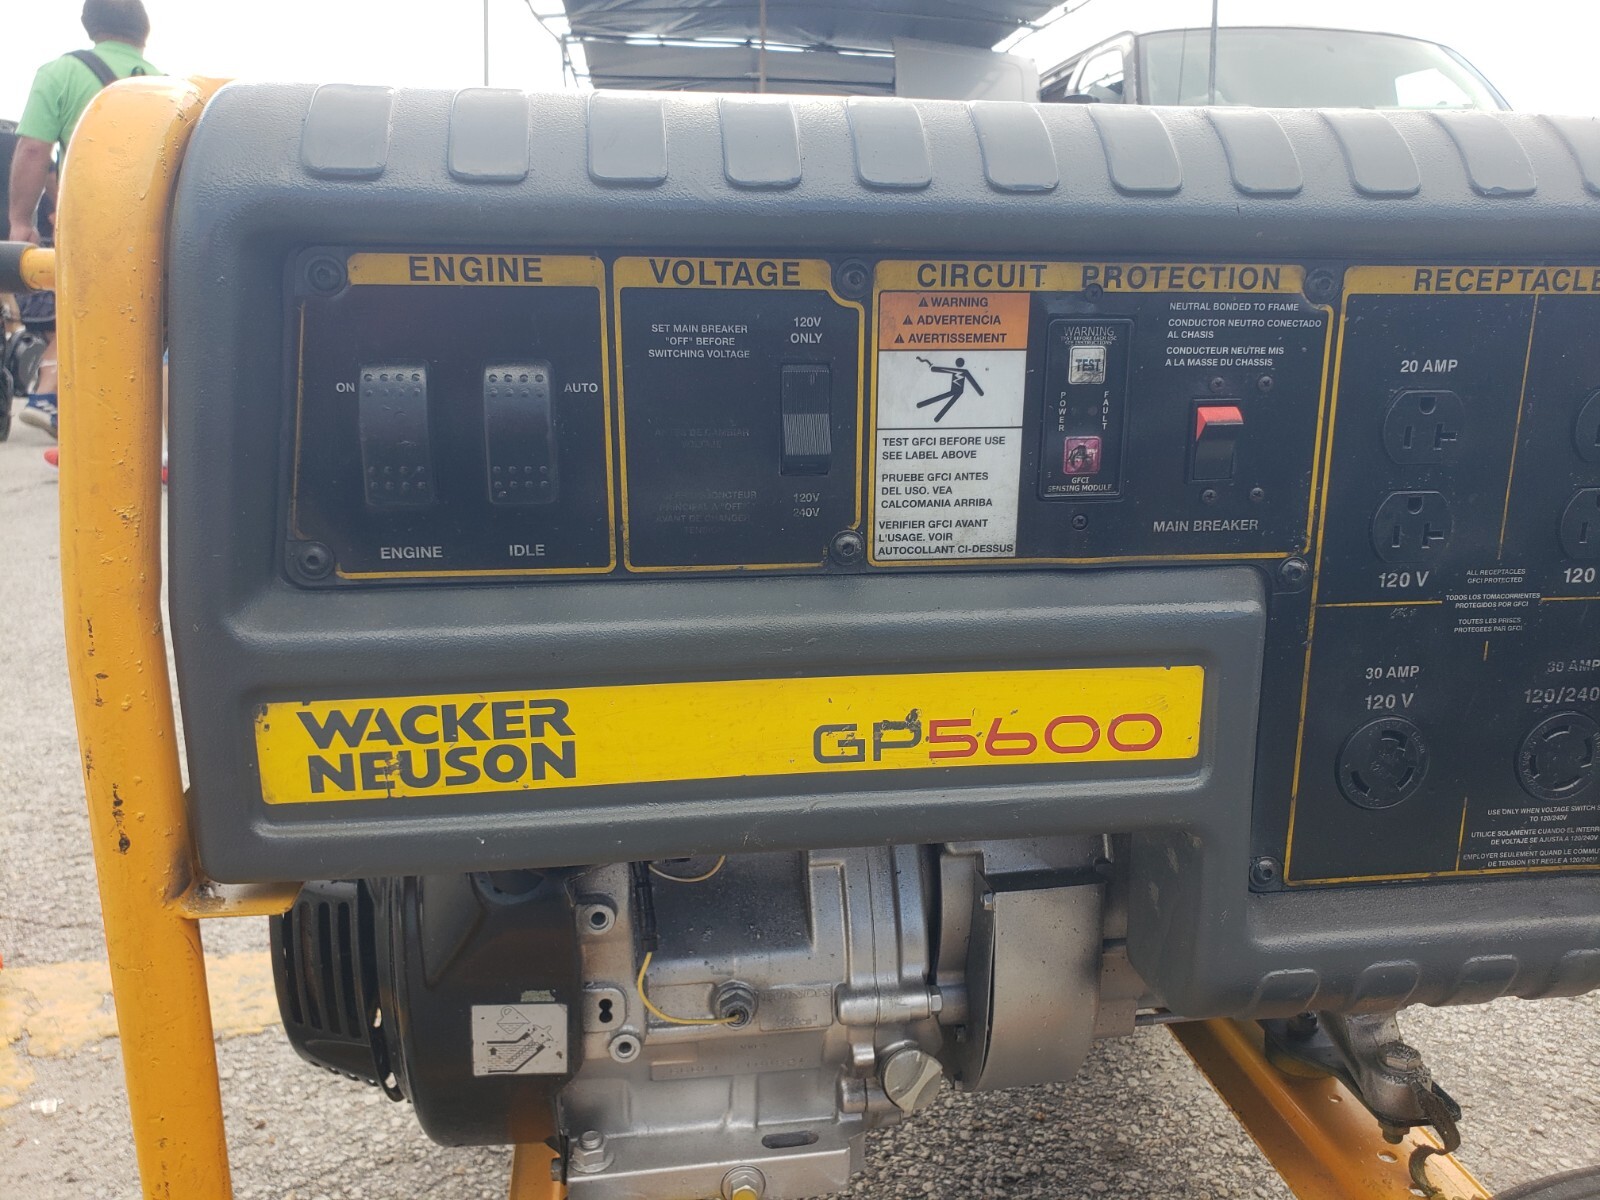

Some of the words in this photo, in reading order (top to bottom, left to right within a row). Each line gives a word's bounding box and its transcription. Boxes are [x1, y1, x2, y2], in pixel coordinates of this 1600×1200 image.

[408, 256, 544, 283] ENGINE
[648, 258, 801, 287] VOLTAGE
[916, 263, 1048, 288] CIRCUIT
[1081, 265, 1281, 291] PROTECTION
[931, 297, 989, 308] WARNING
[1169, 302, 1211, 311] NEUTRAL
[1213, 302, 1251, 311] BONDED
[1253, 303, 1266, 311] TO
[1267, 303, 1299, 312] FRAME
[793, 317, 822, 328] 120V
[916, 314, 1001, 325] ADVERTENCIA
[1168, 319, 1226, 327] CONDUCTOR
[1227, 319, 1265, 328] NEUTRO
[1266, 319, 1322, 328] CONECTADO
[651, 324, 670, 333] SET
[673, 324, 699, 333] MAIN
[701, 325, 748, 334] BREAKER
[1063, 326, 1115, 336] WARNING
[1167, 331, 1179, 339] AL
[1181, 330, 1214, 339] CHASIS
[665, 337, 693, 346] "OFF"
[696, 337, 735, 346] BEFORE
[790, 333, 823, 344] ONLY
[908, 333, 1008, 344] AVERTISSEMENT
[648, 349, 705, 358] SWITCHING
[707, 350, 750, 359] VOLTAGE
[1166, 347, 1229, 355] CONDUCTEUR
[1230, 347, 1266, 355] NEUTRE
[1268, 347, 1285, 355] MIS
[1075, 358, 1101, 372] TEST
[1165, 359, 1172, 367] A
[1173, 359, 1185, 367] LA
[1187, 359, 1218, 367] MASSE
[1220, 359, 1233, 367] DU
[1235, 358, 1273, 367] CHASSIS
[1400, 360, 1419, 373] 20
[1421, 359, 1459, 373] AMP
[335, 382, 356, 393] ON
[563, 382, 598, 394] AUTO
[882, 438, 909, 447] TEST
[911, 437, 937, 446] GFCI
[939, 436, 981, 446] BEFORE
[984, 436, 1006, 445] USE
[882, 451, 903, 460] SEE
[905, 451, 938, 460] LABEL
[941, 450, 977, 459] ABOVE
[881, 473, 924, 482] PRUEBE
[927, 473, 951, 481] GFCI
[954, 472, 989, 481] ANTES
[881, 487, 902, 495] DEL
[904, 486, 929, 495] USO.
[932, 486, 953, 495] VEA
[793, 493, 820, 502] 120V
[881, 499, 951, 508] CALCOMANIA
[953, 498, 993, 507] ARRIBA
[793, 508, 820, 517] 240V
[878, 520, 925, 529] VERIFIER
[928, 520, 952, 529] GFCI
[954, 519, 988, 528] AVANT
[1153, 520, 1189, 532] MAIN
[1192, 519, 1259, 532] BREAKER
[878, 533, 925, 543] L'USAGE.
[928, 532, 953, 541] VOIR
[380, 546, 443, 560] ENGINE
[508, 544, 546, 557] IDLE
[878, 545, 955, 556] AUTOCOLLANT
[957, 544, 1014, 554] CI-DESSUS
[1479, 568, 1526, 576] RECEPTACLES
[1563, 567, 1596, 583] 120
[1378, 572, 1411, 588] 120
[1416, 571, 1430, 587] V
[1482, 592, 1541, 600] TOMACORRIENTES
[1547, 660, 1565, 673] 30
[1567, 659, 1600, 672] AMP
[1365, 667, 1382, 680] 30
[1386, 665, 1420, 679] AMP
[1524, 686, 1600, 704] 120/240
[1364, 694, 1396, 710] 120
[1401, 693, 1414, 708] V
[295, 698, 576, 750] WACKER
[812, 712, 1163, 764] GP5600
[307, 740, 577, 794] NEUSON
[1540, 814, 1568, 822] 120/240V
[1497, 829, 1537, 837] SOLAMENTE
[1463, 852, 1499, 860] EMPLOYER
[1499, 850, 1539, 859] SEULEMENT
[1498, 859, 1526, 867] TENSION
